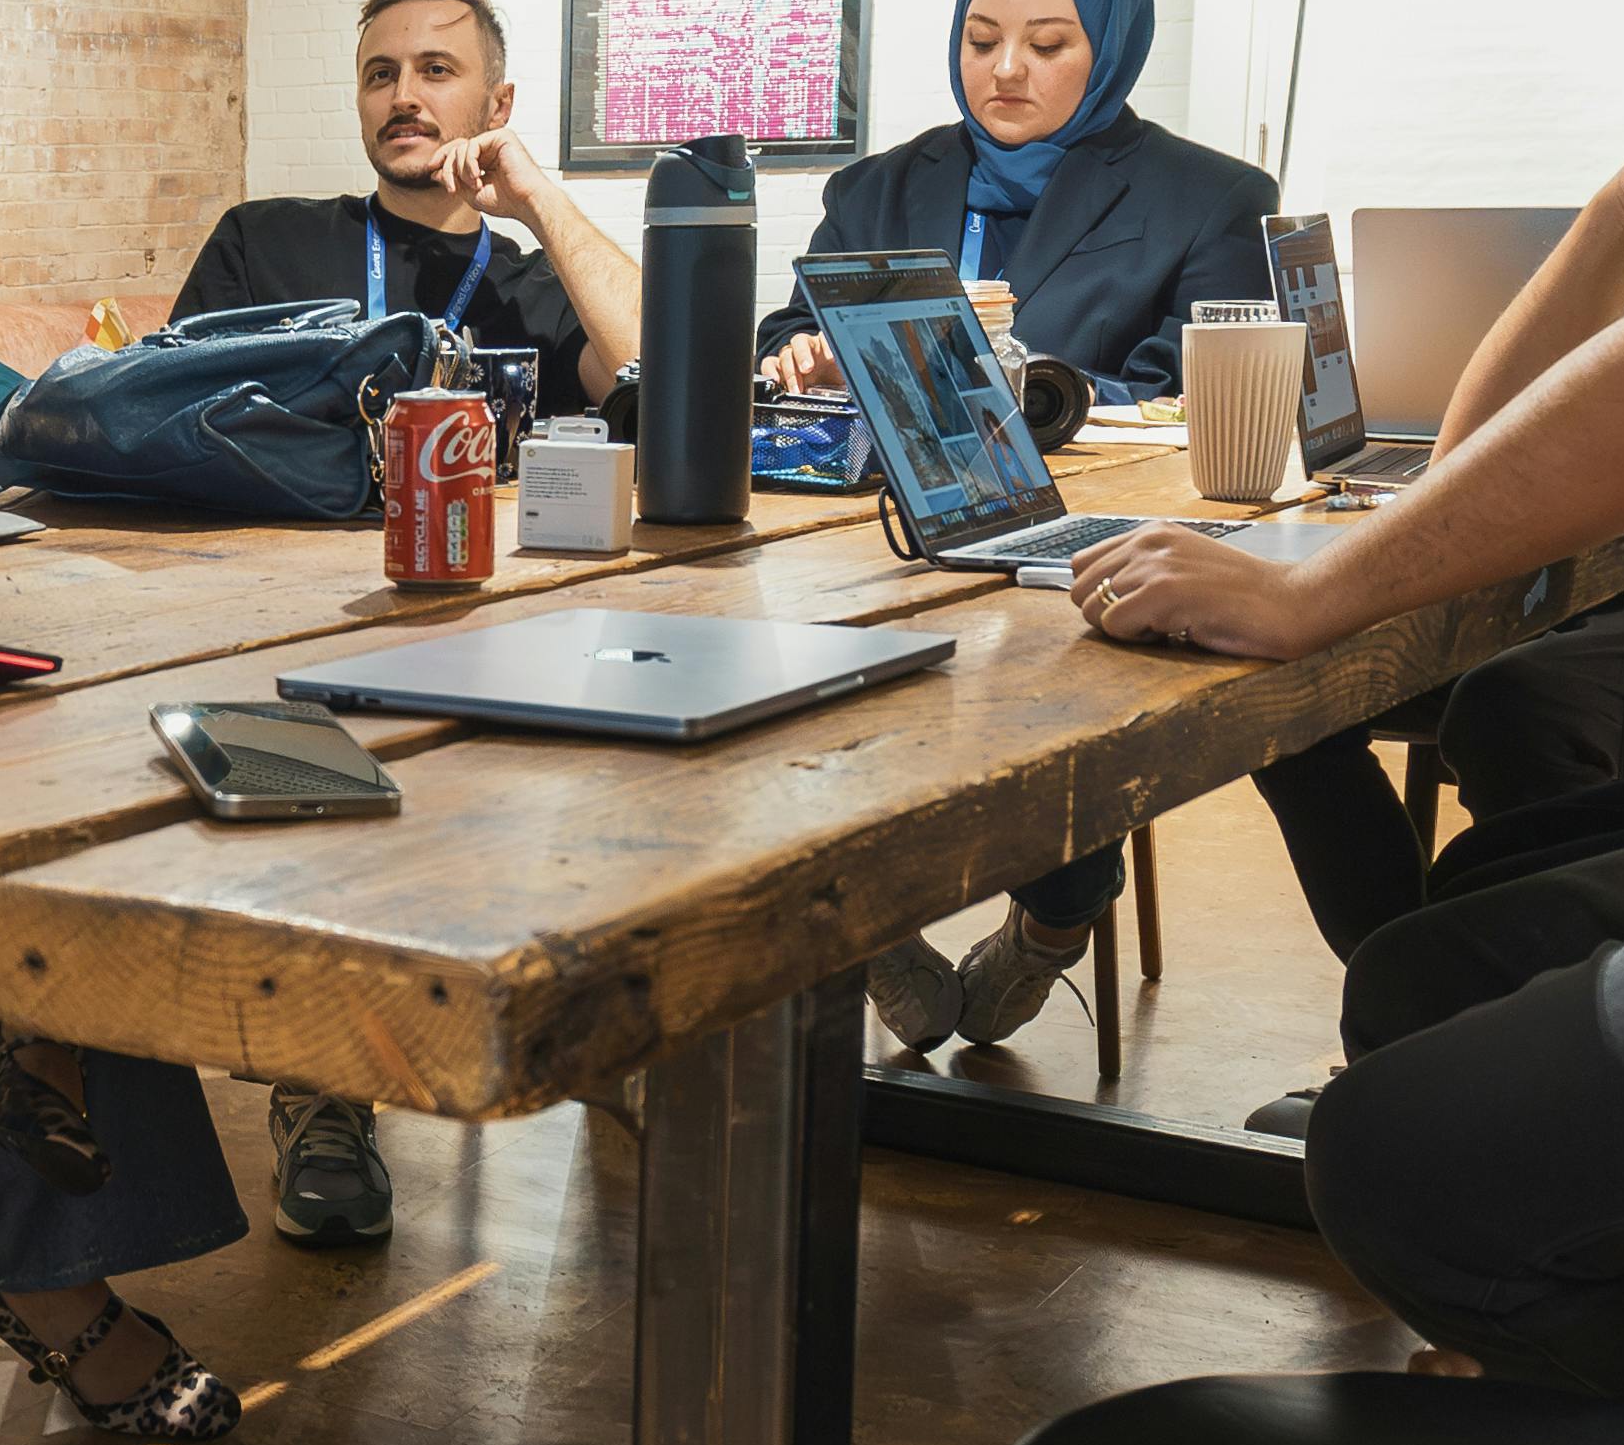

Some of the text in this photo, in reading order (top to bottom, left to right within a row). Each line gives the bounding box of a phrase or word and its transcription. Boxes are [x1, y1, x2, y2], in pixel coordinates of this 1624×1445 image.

[370, 253, 382, 279] Canva
[414, 489, 425, 572] RECYCLE ME
